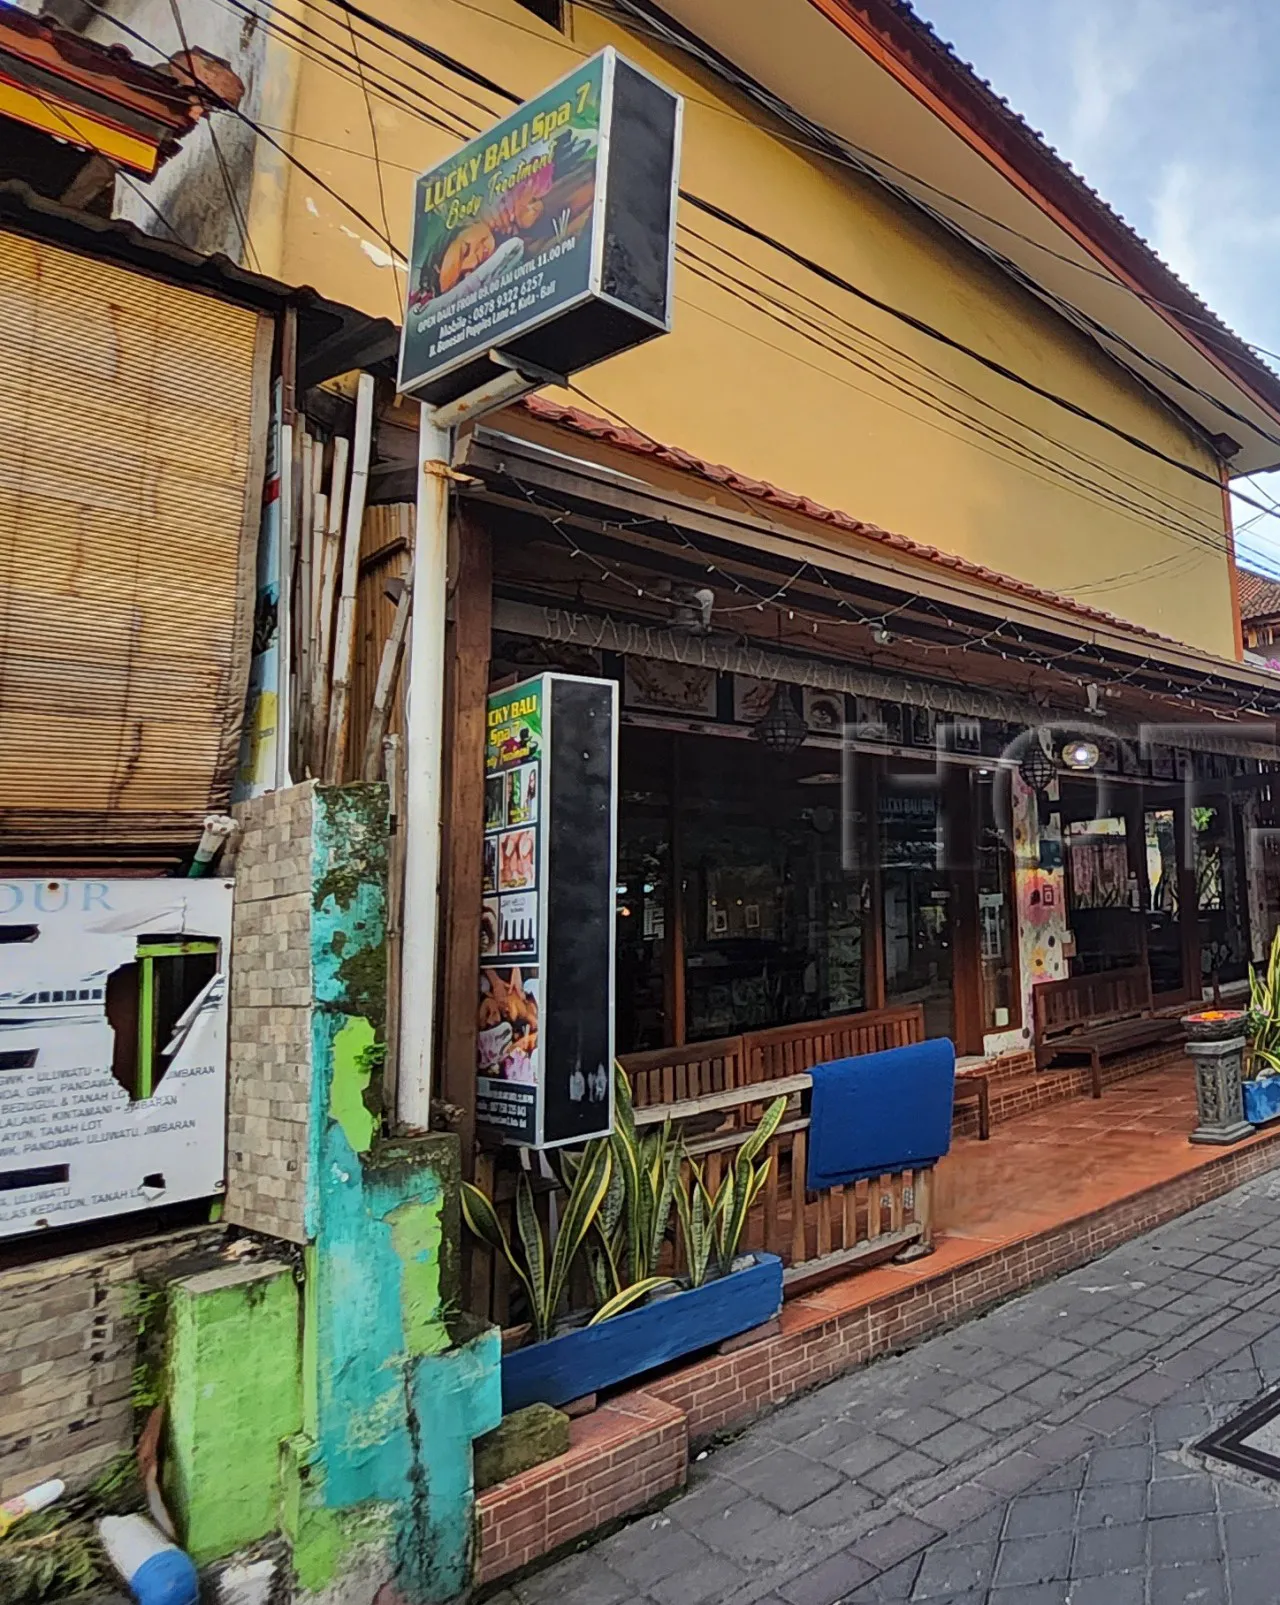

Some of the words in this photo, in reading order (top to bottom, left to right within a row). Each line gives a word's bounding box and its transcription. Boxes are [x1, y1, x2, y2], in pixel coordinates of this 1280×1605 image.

[424, 153, 482, 213] LUCKY
[483, 123, 528, 174] BALI
[531, 102, 571, 142] Spa
[576, 80, 592, 114] 7
[538, 245, 560, 267] 11.00
[562, 236, 576, 254] PM
[488, 704, 511, 727] CKY
[511, 695, 537, 718] BALI
[490, 728, 511, 747] Spa
[72, 1093, 108, 1105] TANAH
[40, 1123, 79, 1136] TANAH
[81, 1119, 103, 1132] LOT
